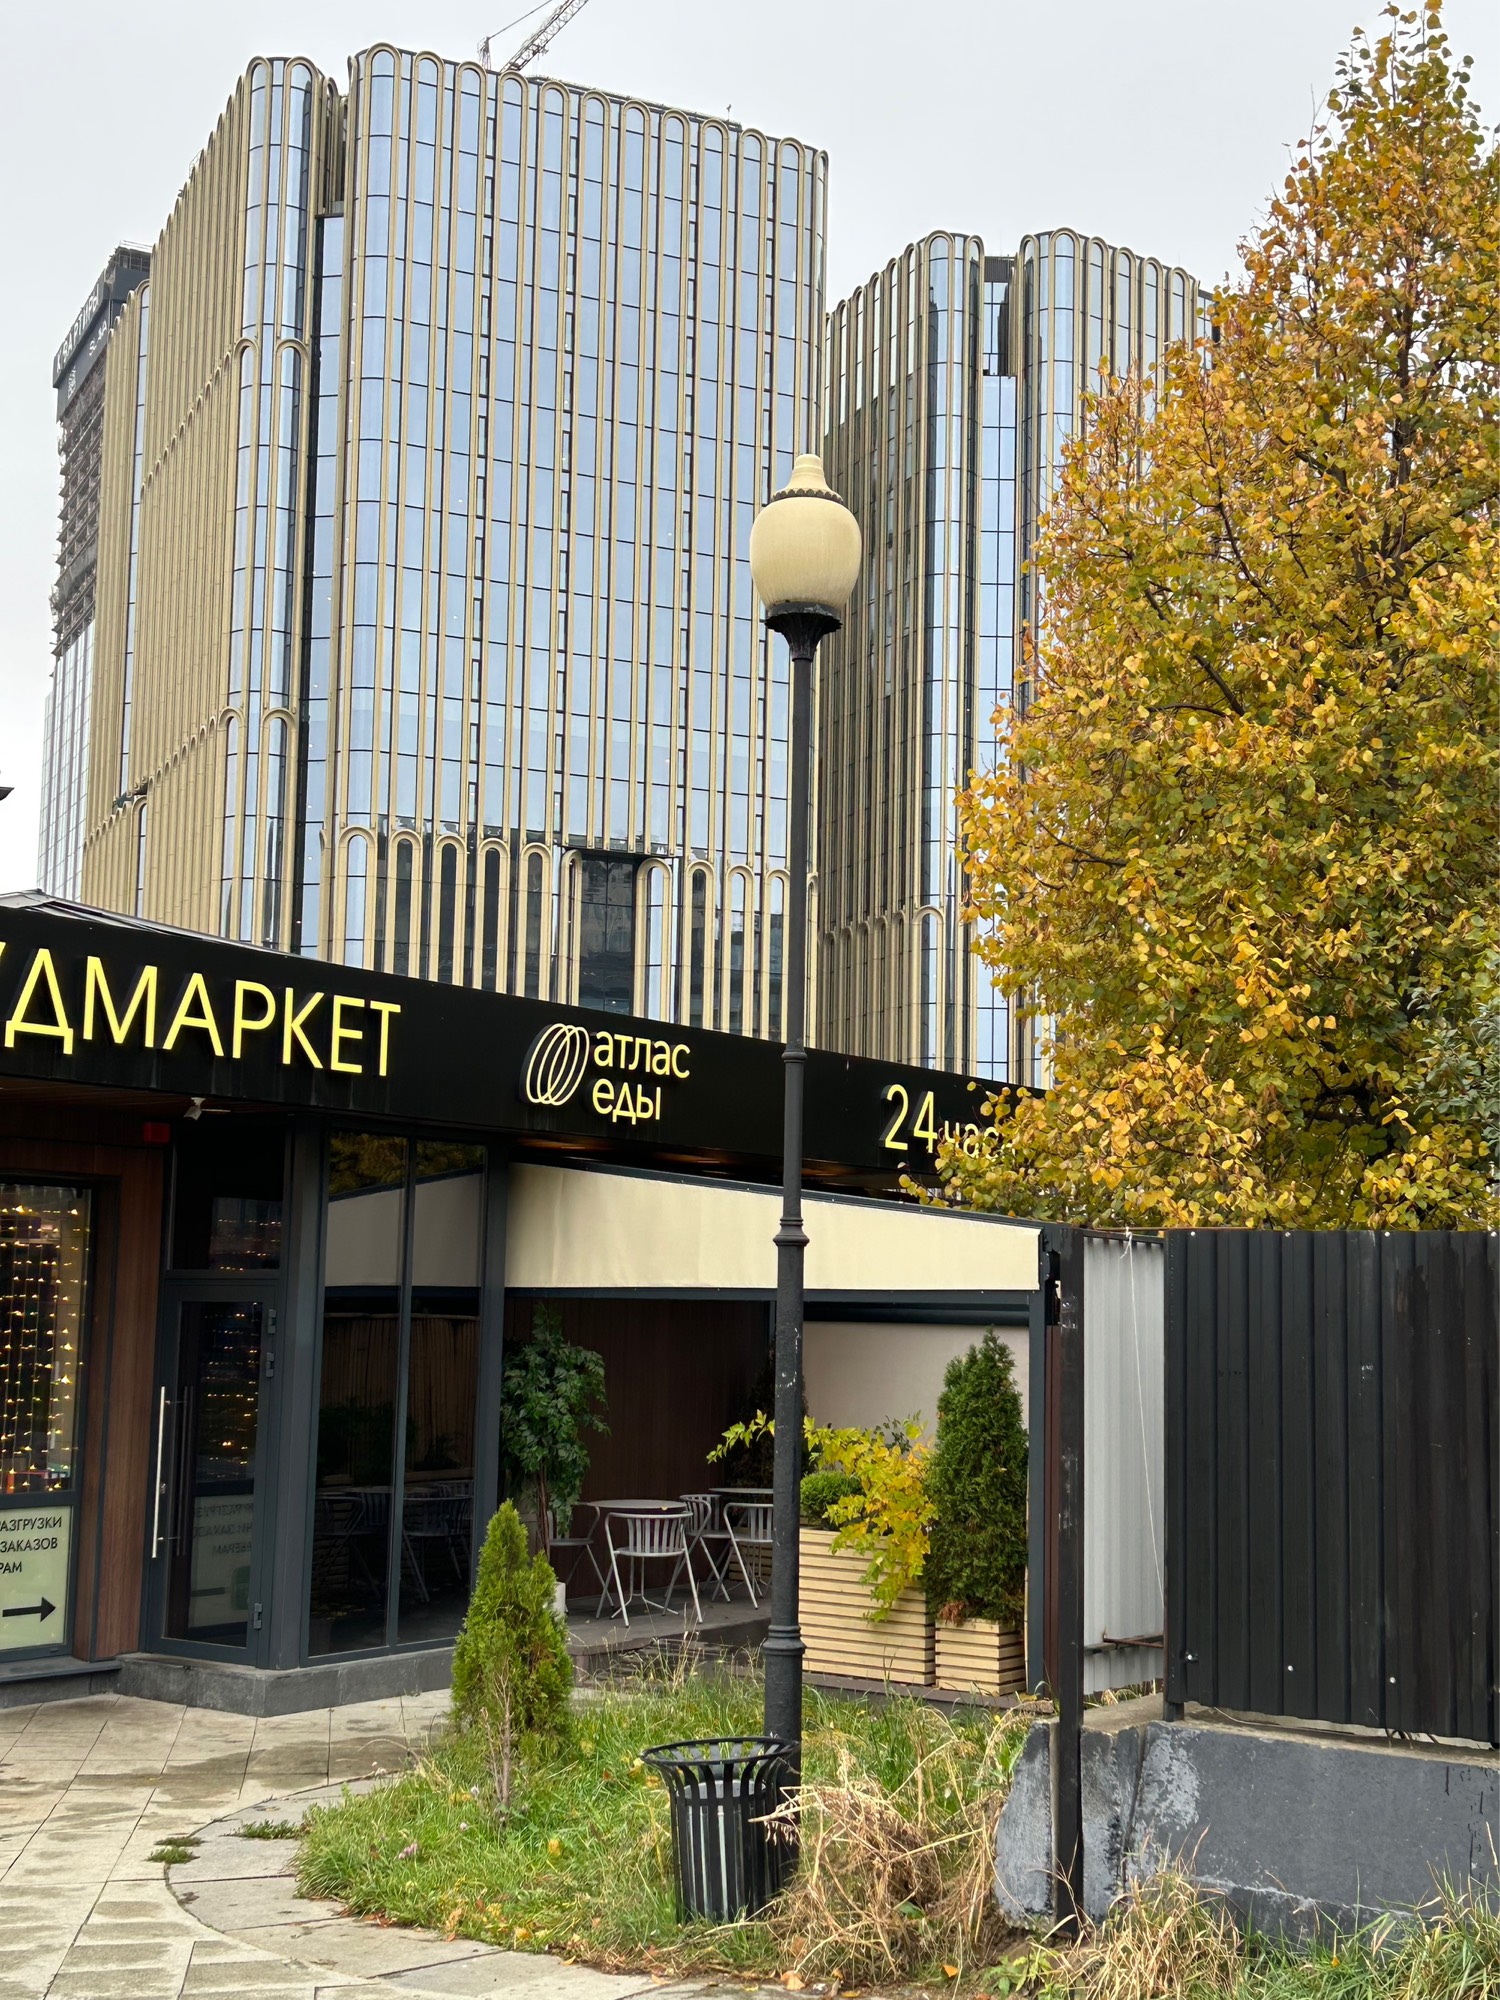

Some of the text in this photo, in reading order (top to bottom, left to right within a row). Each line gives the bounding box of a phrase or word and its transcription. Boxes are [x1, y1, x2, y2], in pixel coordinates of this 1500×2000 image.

[0, 941, 401, 1077] ДМАРКЕТ
[593, 1031, 691, 1080] атлас
[592, 1077, 661, 1125] еды
[885, 1084, 938, 1154] 24
[0, 1516, 62, 1532] АЗГРУЗКИ
[0, 1537, 58, 1553] ЗАКАЗОВ
